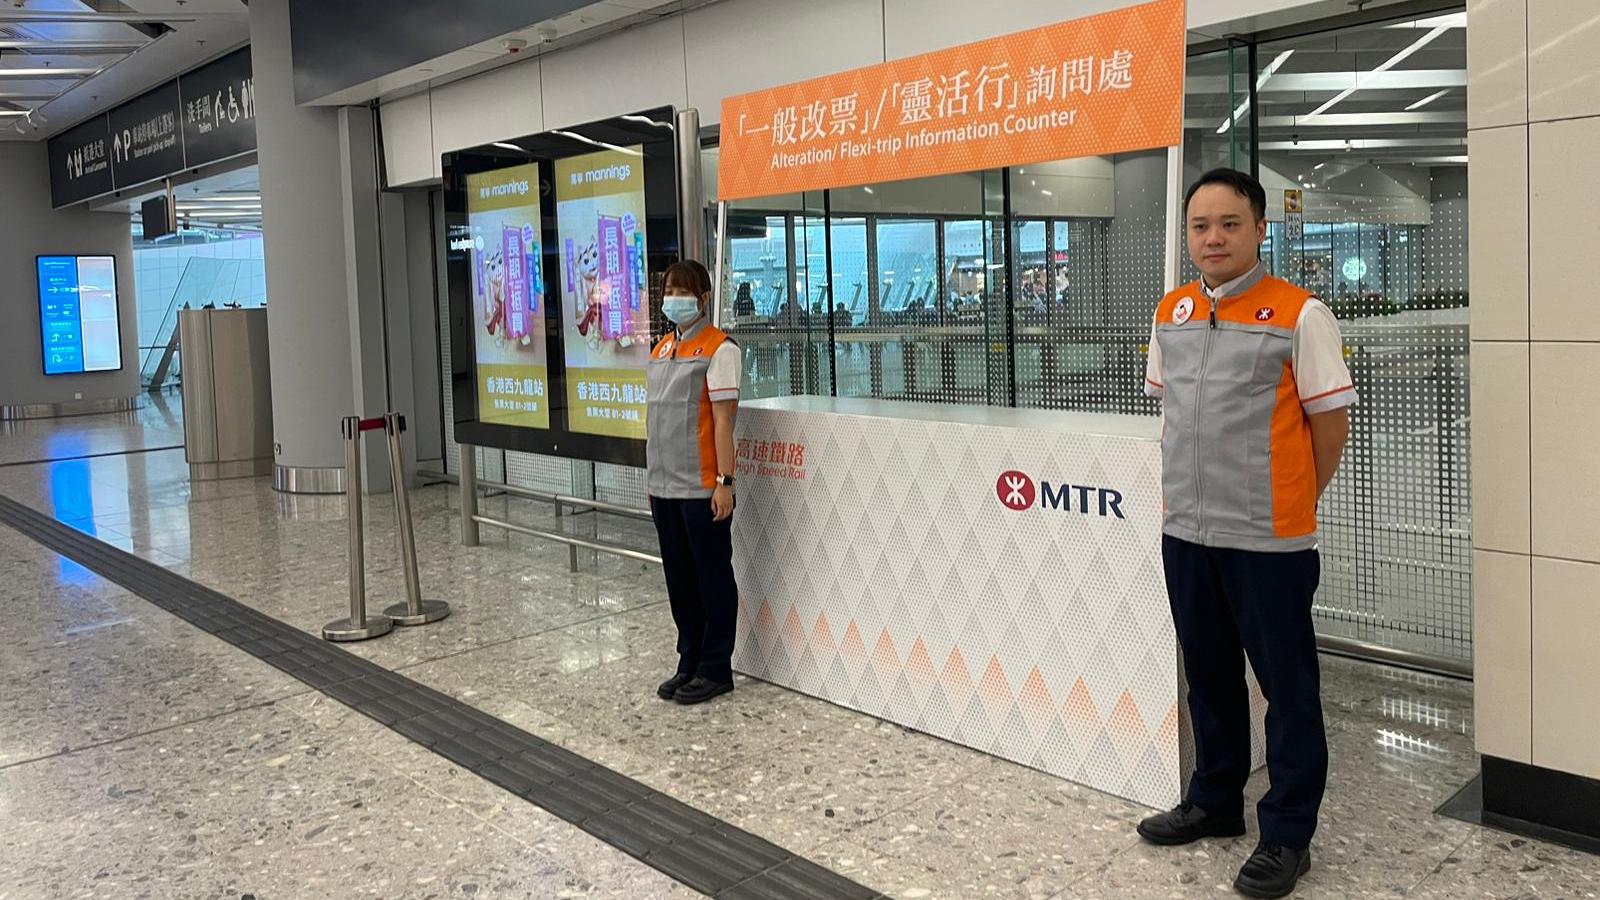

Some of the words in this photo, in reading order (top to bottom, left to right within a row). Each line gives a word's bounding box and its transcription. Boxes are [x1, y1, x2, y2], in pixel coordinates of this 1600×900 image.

[187, 94, 211, 124] 洗手間
[771, 143, 838, 169] Alteration/
[840, 134, 902, 158] Flexi-trip
[905, 121, 999, 150] Information
[1004, 108, 1077, 135] Counter
[585, 163, 631, 184] mannings
[492, 179, 529, 198] mannings
[487, 376, 544, 397] 香港西九龍站
[577, 381, 647, 404] 香港西九龍站
[736, 438, 805, 466] 高速鐵路
[757, 462, 787, 478] Speed
[788, 467, 807, 480] Rail
[1040, 481, 1125, 519] MTR
